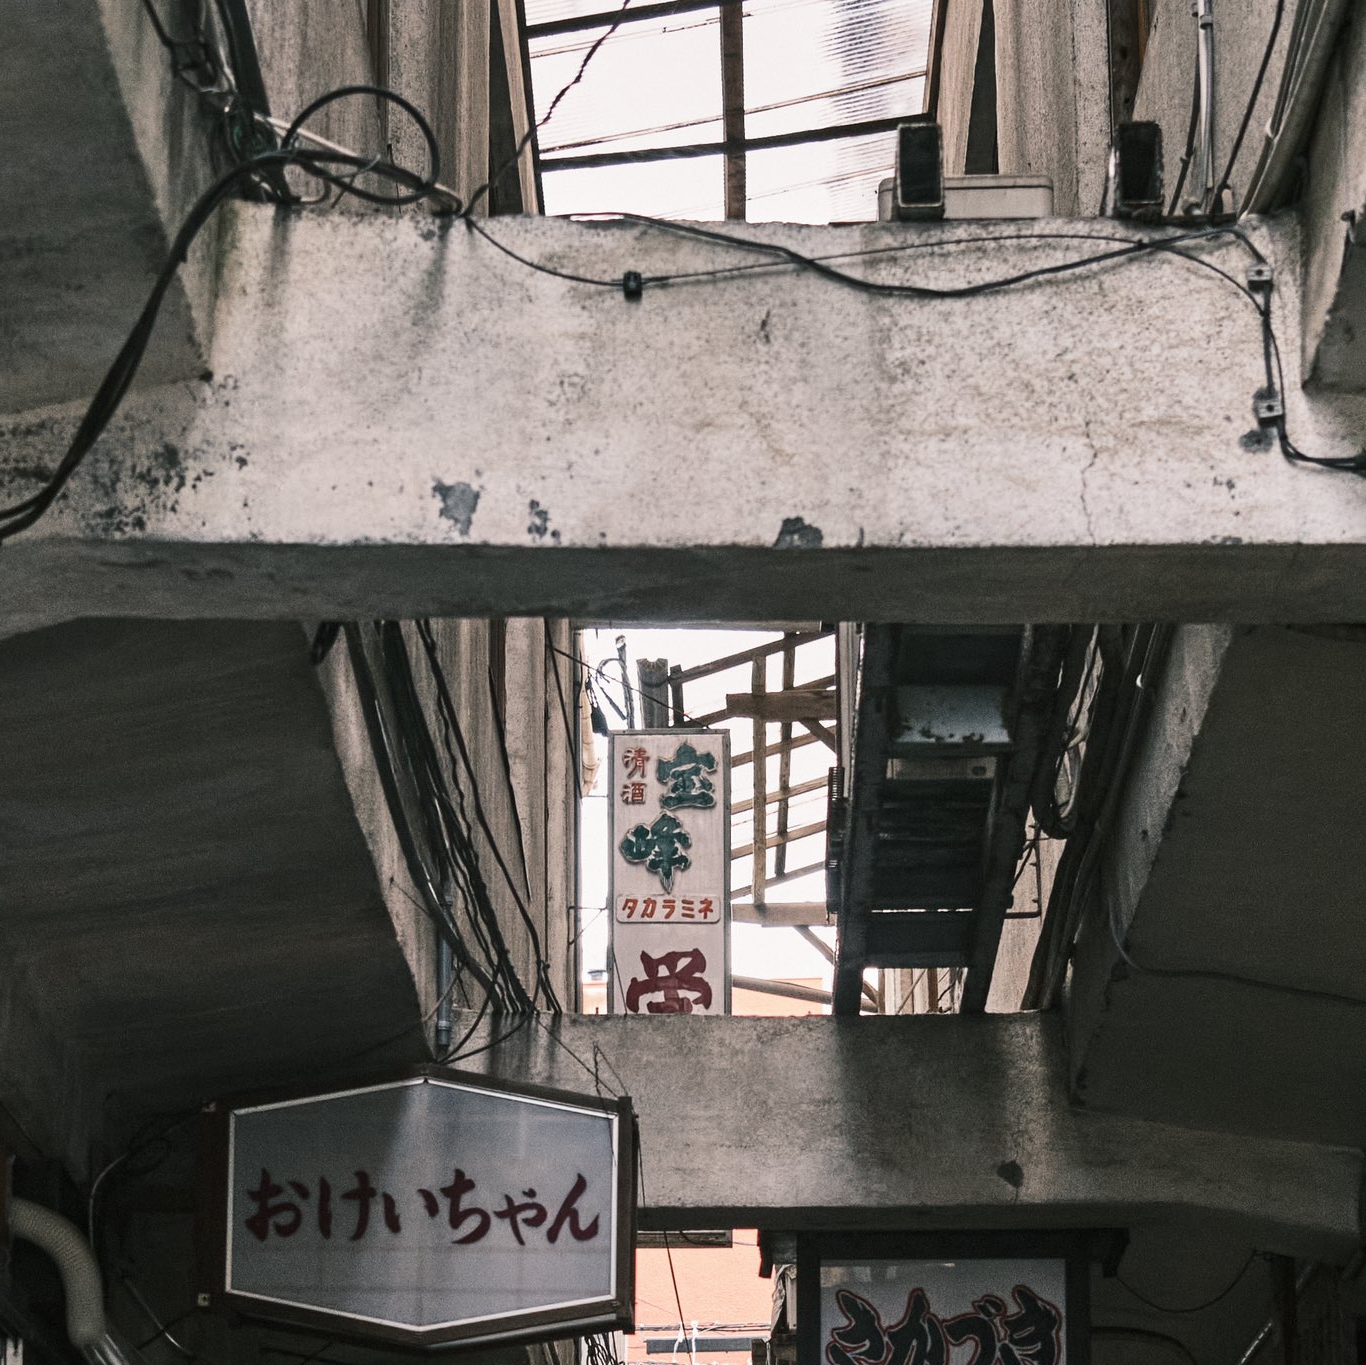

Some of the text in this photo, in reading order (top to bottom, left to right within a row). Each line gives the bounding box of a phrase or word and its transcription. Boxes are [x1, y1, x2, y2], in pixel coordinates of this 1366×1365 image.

[621, 746, 650, 805] 清酒
[622, 897, 715, 919] タカラミネ
[246, 1168, 600, 1246] おけいちゃん
